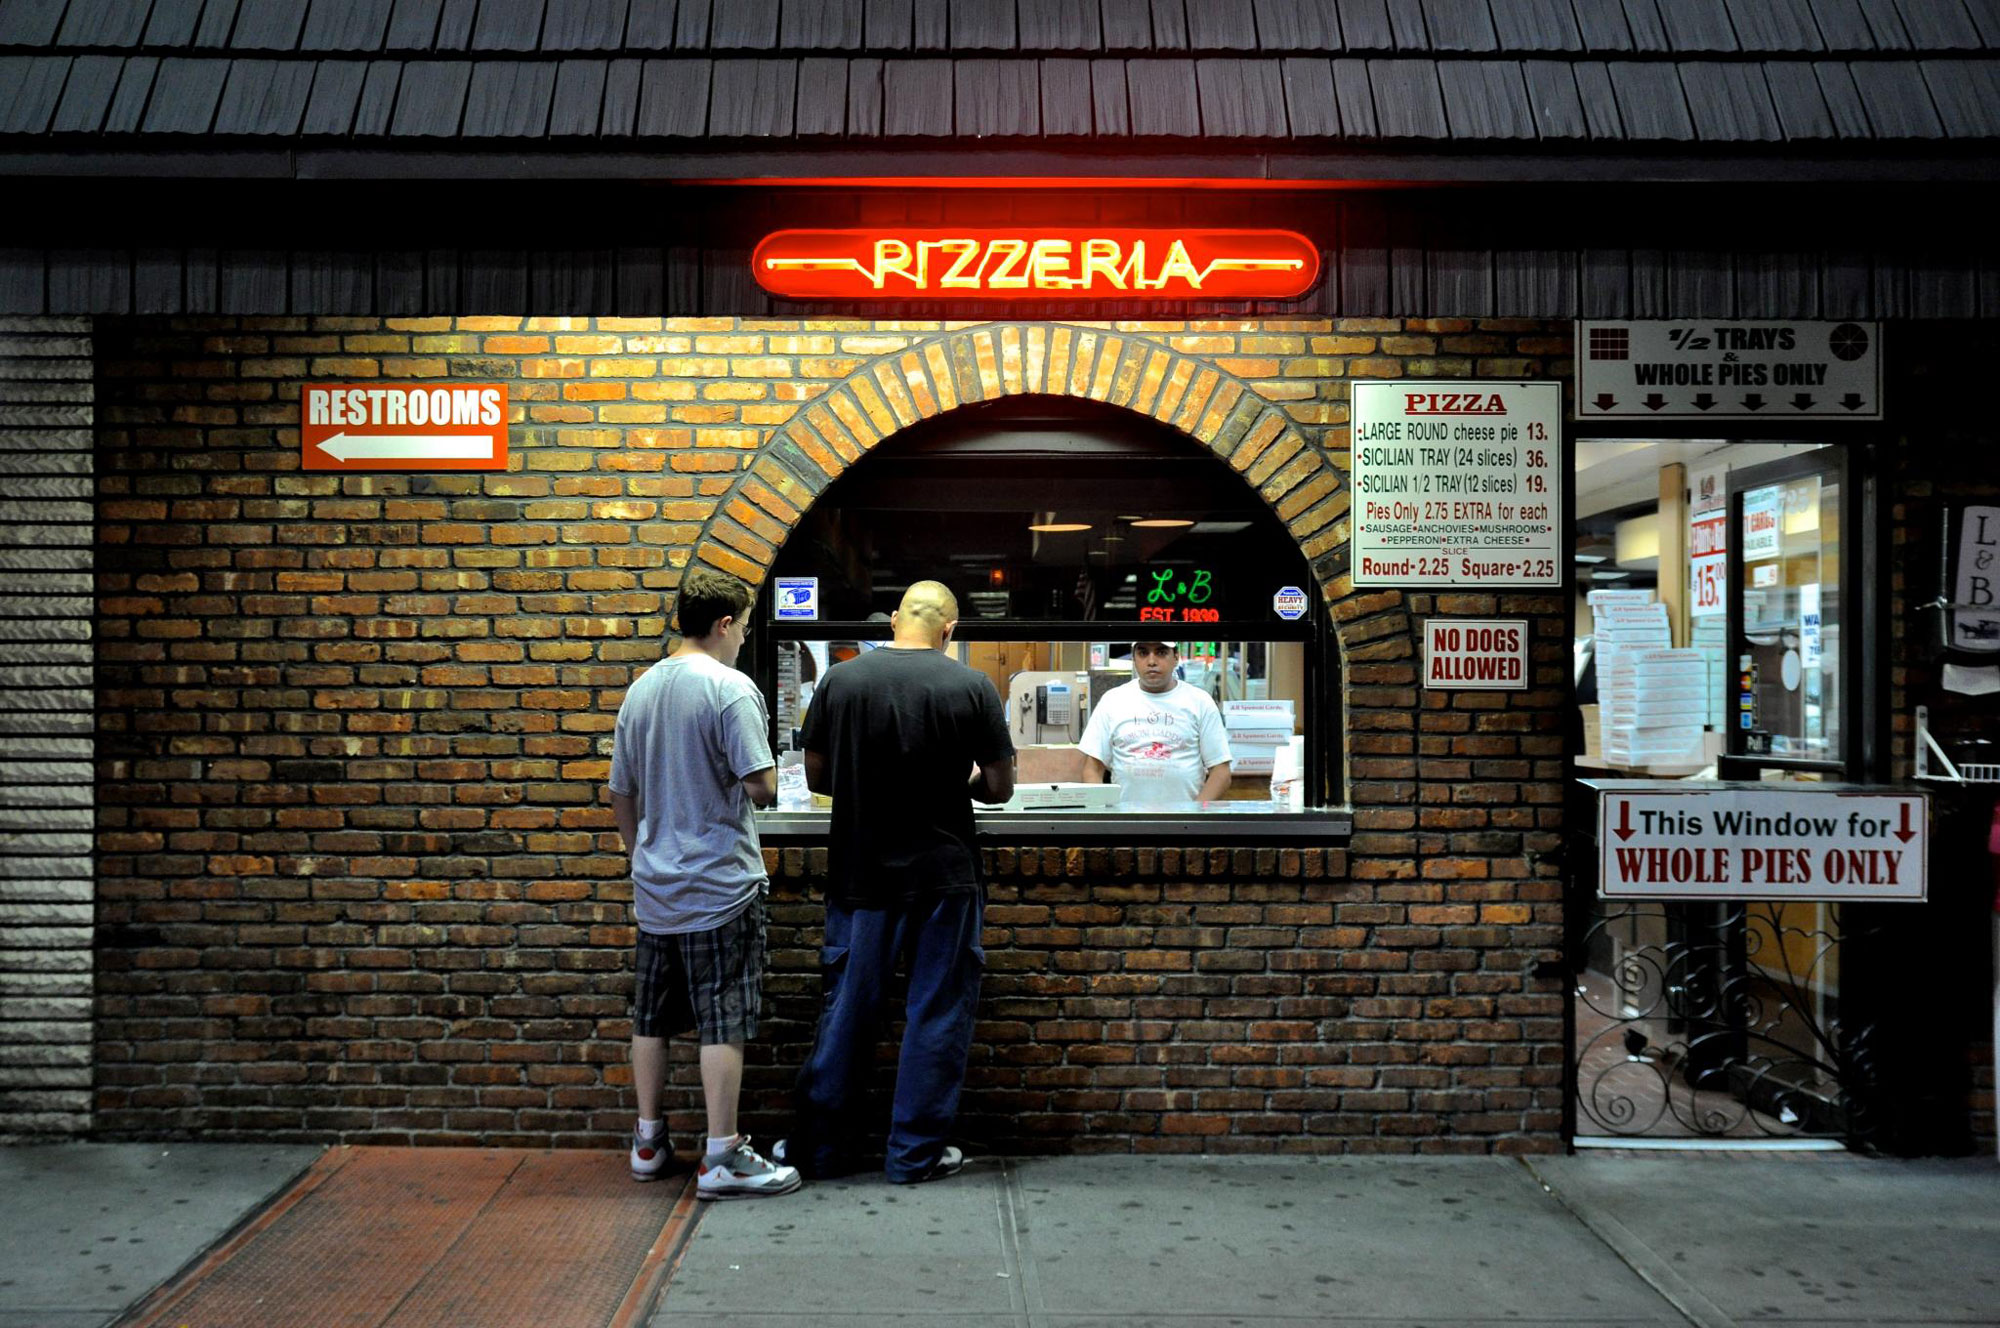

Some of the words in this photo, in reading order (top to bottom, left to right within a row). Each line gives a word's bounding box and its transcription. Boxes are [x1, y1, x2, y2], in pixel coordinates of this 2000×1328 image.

[873, 239, 1205, 290] PIZZERIA
[1714, 327, 1796, 351] TRAYS
[1722, 352, 1740, 362] &
[1634, 363, 1714, 386] WHOLE
[1718, 363, 1768, 386] PIES
[1773, 363, 1828, 386] ONLY
[308, 388, 501, 426] RESTROOMS
[1404, 393, 1508, 412] PIZZA
[1362, 422, 1402, 441] LARGE
[1407, 422, 1449, 441] ROUND
[1453, 423, 1495, 442] cheese
[1500, 423, 1518, 444] pie
[1526, 422, 1549, 441] 13.
[1361, 448, 1414, 466] SICILIAN
[1420, 448, 1451, 466] TRAY
[1453, 446, 1474, 468] (24
[1477, 446, 1518, 468] slices)
[1526, 450, 1549, 468] 36.
[1361, 475, 1408, 493] SICILIAN
[1412, 474, 1430, 494] 1/2
[1434, 475, 1463, 493] TRAY
[1463, 473, 1479, 494] (12
[1481, 473, 1518, 494] slices)
[1525, 475, 1548, 493] 19.
[1366, 501, 1391, 520] Pies
[1393, 501, 1419, 523] Only
[1424, 501, 1448, 520] 2.75
[1453, 502, 1492, 520] EXTRA
[1498, 502, 1514, 520] for
[1520, 502, 1548, 520] each
[1365, 524, 1412, 533] SAUSAGE
[1417, 524, 1475, 533] ANCHOVIES
[1479, 524, 1547, 534] MUSHROOMS
[1387, 536, 1442, 545] PEPPERONI
[1446, 536, 1479, 545] EXTRA
[1484, 536, 1525, 545] CHEESE
[1441, 548, 1469, 556] SLICE
[1418, 557, 1449, 576] 2.25
[1523, 559, 1554, 577] 2.25
[1434, 628, 1460, 652] NO
[1465, 628, 1519, 652] DOGS
[1431, 656, 1521, 680] ALLOWED
[1639, 810, 1703, 836] This
[1713, 811, 1838, 837] Window
[1847, 811, 1891, 838] for
[1615, 847, 1729, 883] WHOLE
[1741, 848, 1812, 884] PIES
[1823, 849, 1903, 885] ONLY
